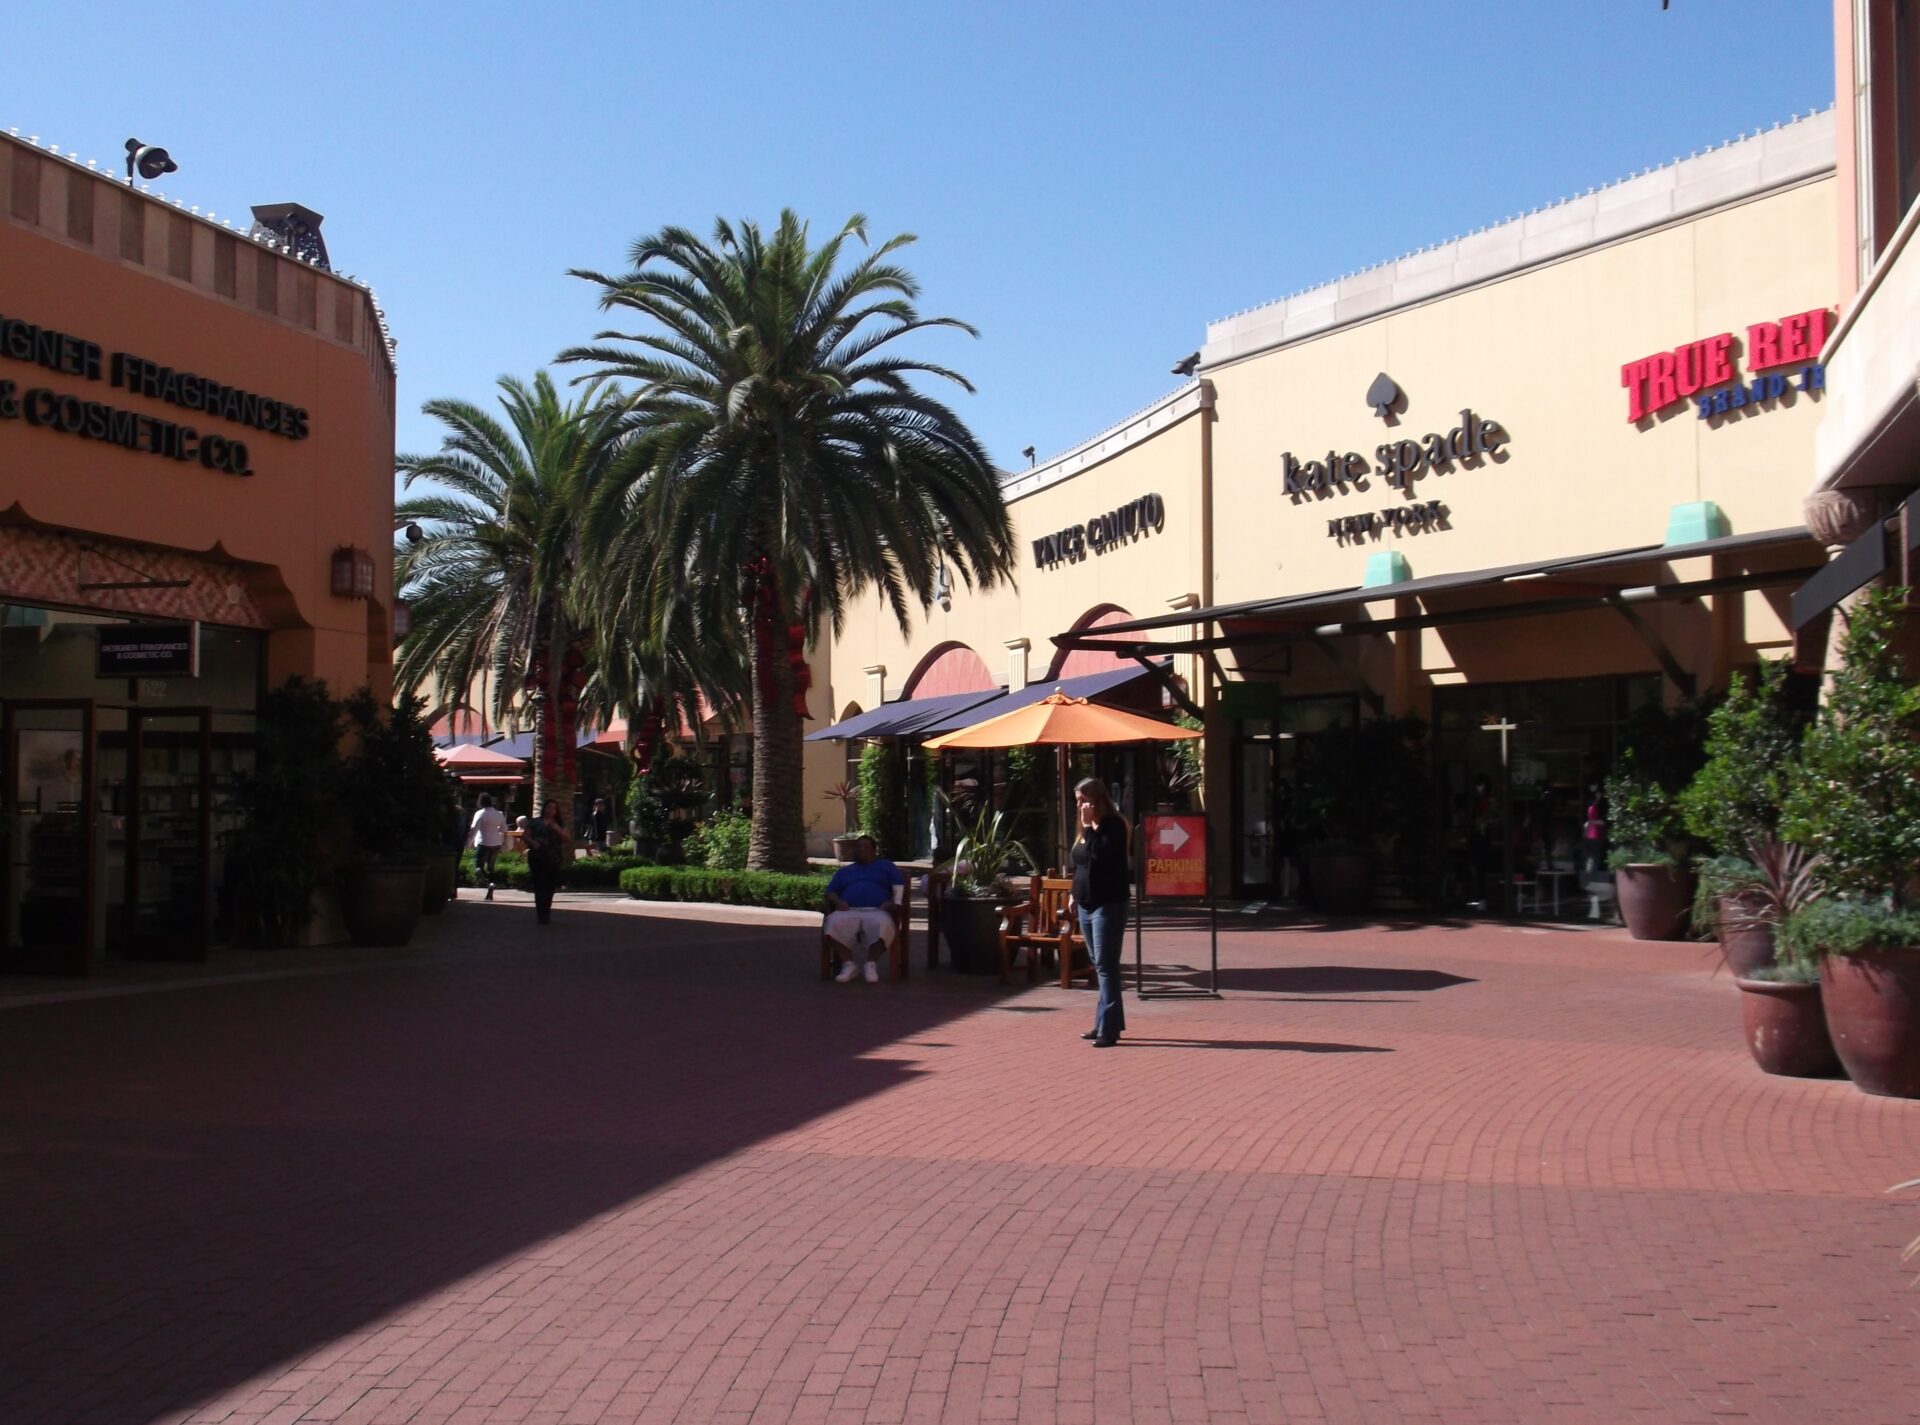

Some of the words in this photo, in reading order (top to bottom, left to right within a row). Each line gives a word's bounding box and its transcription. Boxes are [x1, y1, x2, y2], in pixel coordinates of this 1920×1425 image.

[111, 352, 309, 440] FRAGRANCES
[1621, 332, 1734, 424] TRUE
[1697, 373, 1789, 420] BRAND
[0, 379, 18, 418] &
[25, 388, 200, 460] COSMETIC
[201, 434, 255, 476] CO.
[1281, 451, 1364, 495] kate
[1375, 408, 1502, 489] spade
[1032, 524, 1086, 568] VINCE
[1087, 492, 1164, 549] CAMUTO
[1327, 512, 1375, 537] NEW
[1380, 500, 1441, 529] YORK
[1148, 859, 1204, 872] PARKING
